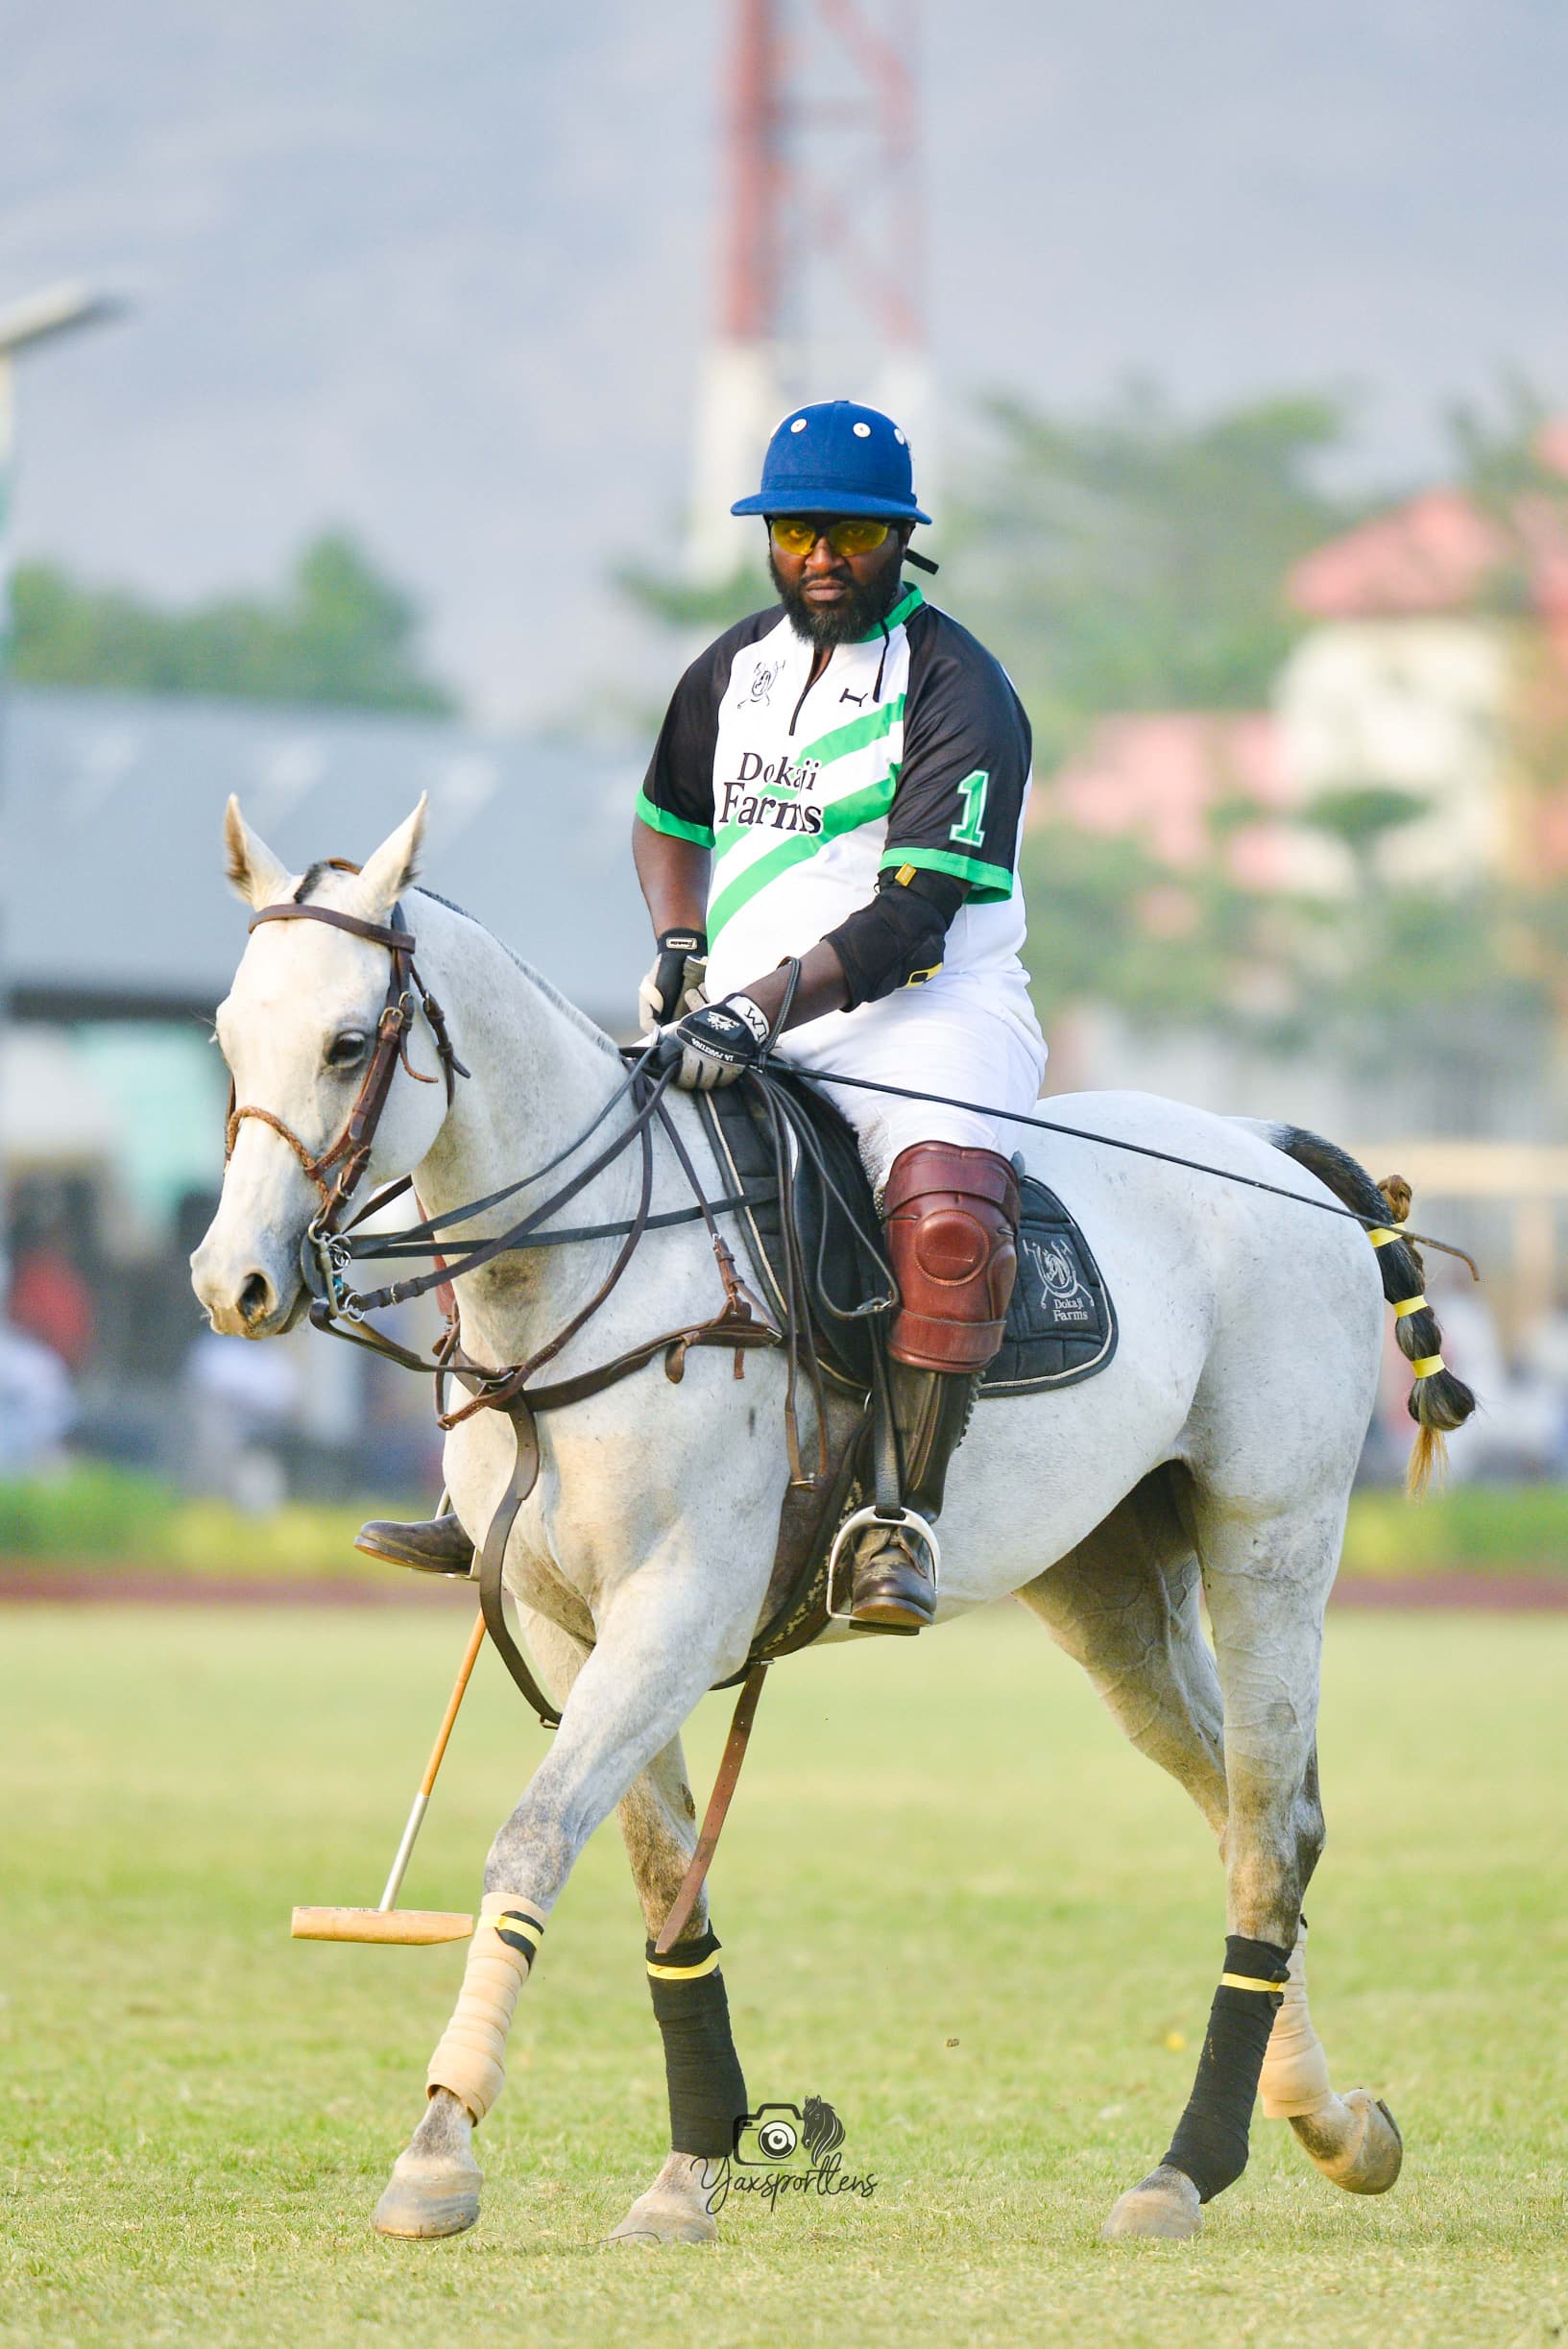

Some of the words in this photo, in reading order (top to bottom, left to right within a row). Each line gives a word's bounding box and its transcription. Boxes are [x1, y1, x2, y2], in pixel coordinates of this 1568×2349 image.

[949, 769, 990, 848] 1
[1053, 1297, 1083, 1310] Dokaji
[1052, 1309, 1089, 1321] Farms
